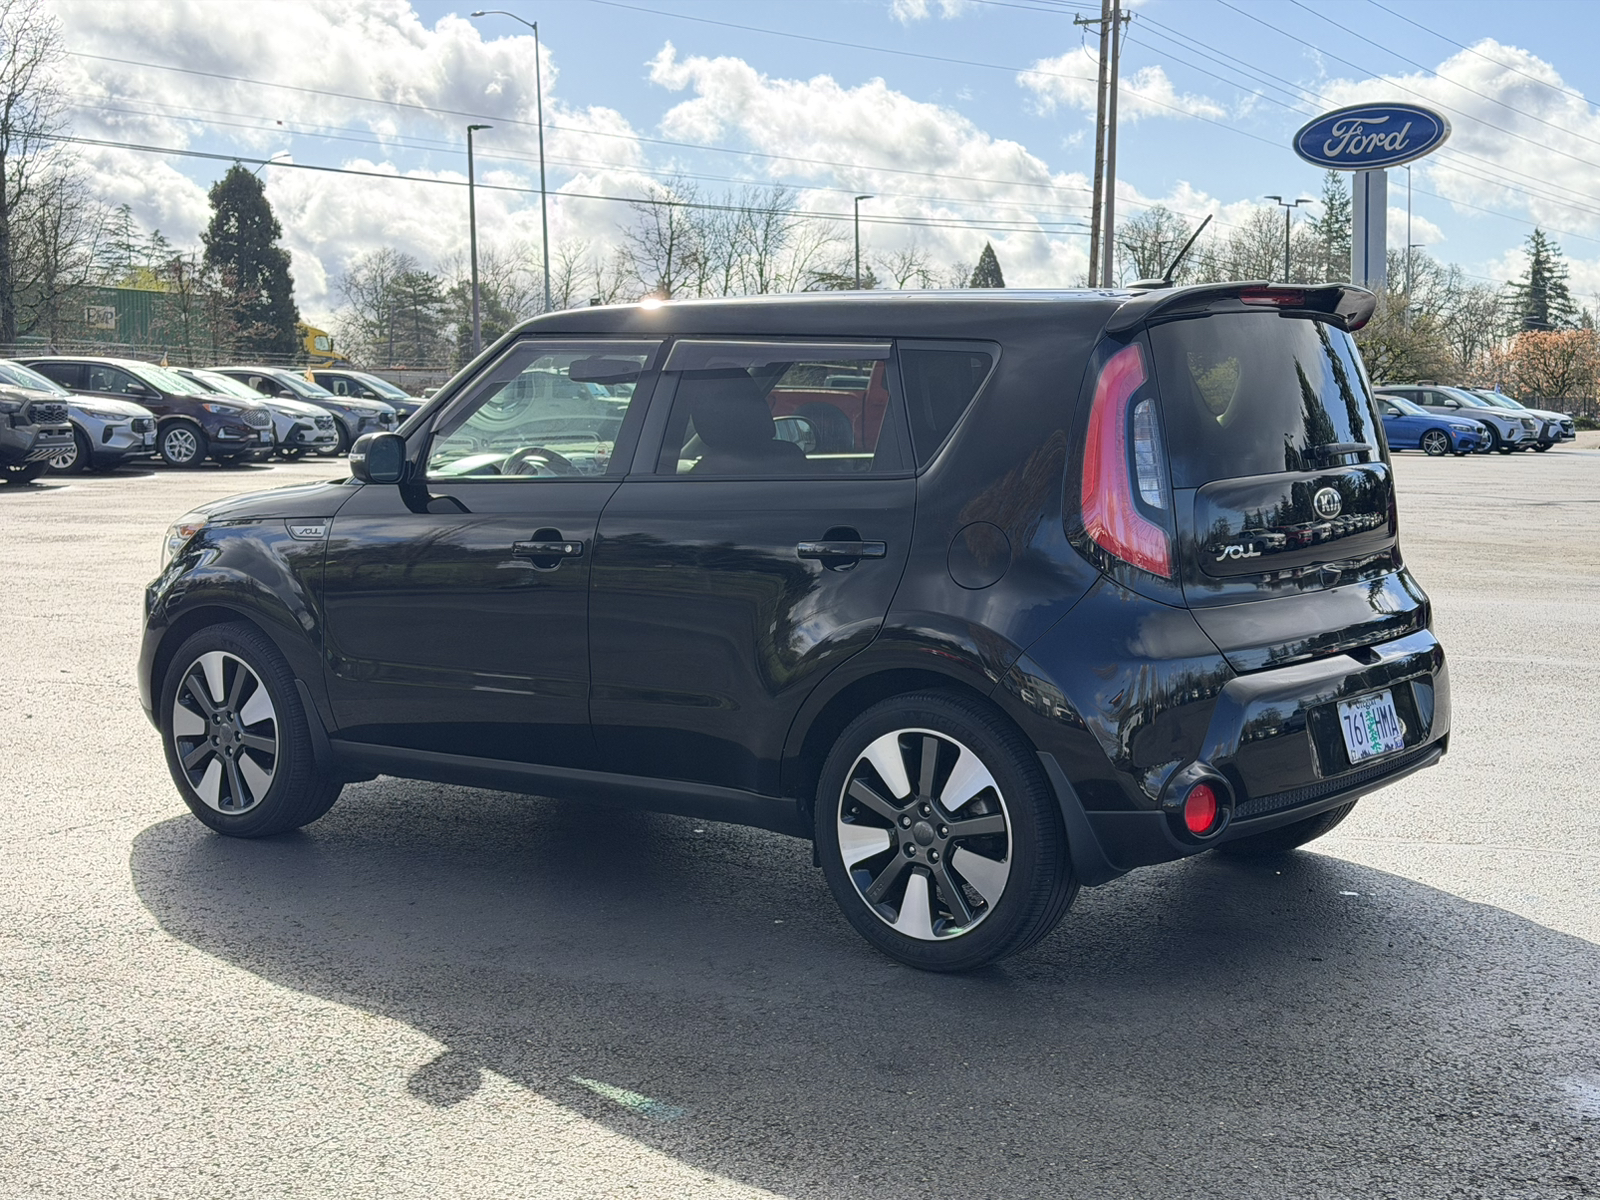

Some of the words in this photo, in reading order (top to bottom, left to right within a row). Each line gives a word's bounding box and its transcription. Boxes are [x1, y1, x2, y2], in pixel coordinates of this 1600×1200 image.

[1323, 115, 1412, 157] Ford
[1319, 493, 1341, 513] KIA
[299, 527, 322, 535] SOUL
[1216, 543, 1262, 562] SOUL
[1343, 711, 1370, 748] 761
[1372, 704, 1400, 740] HMA
